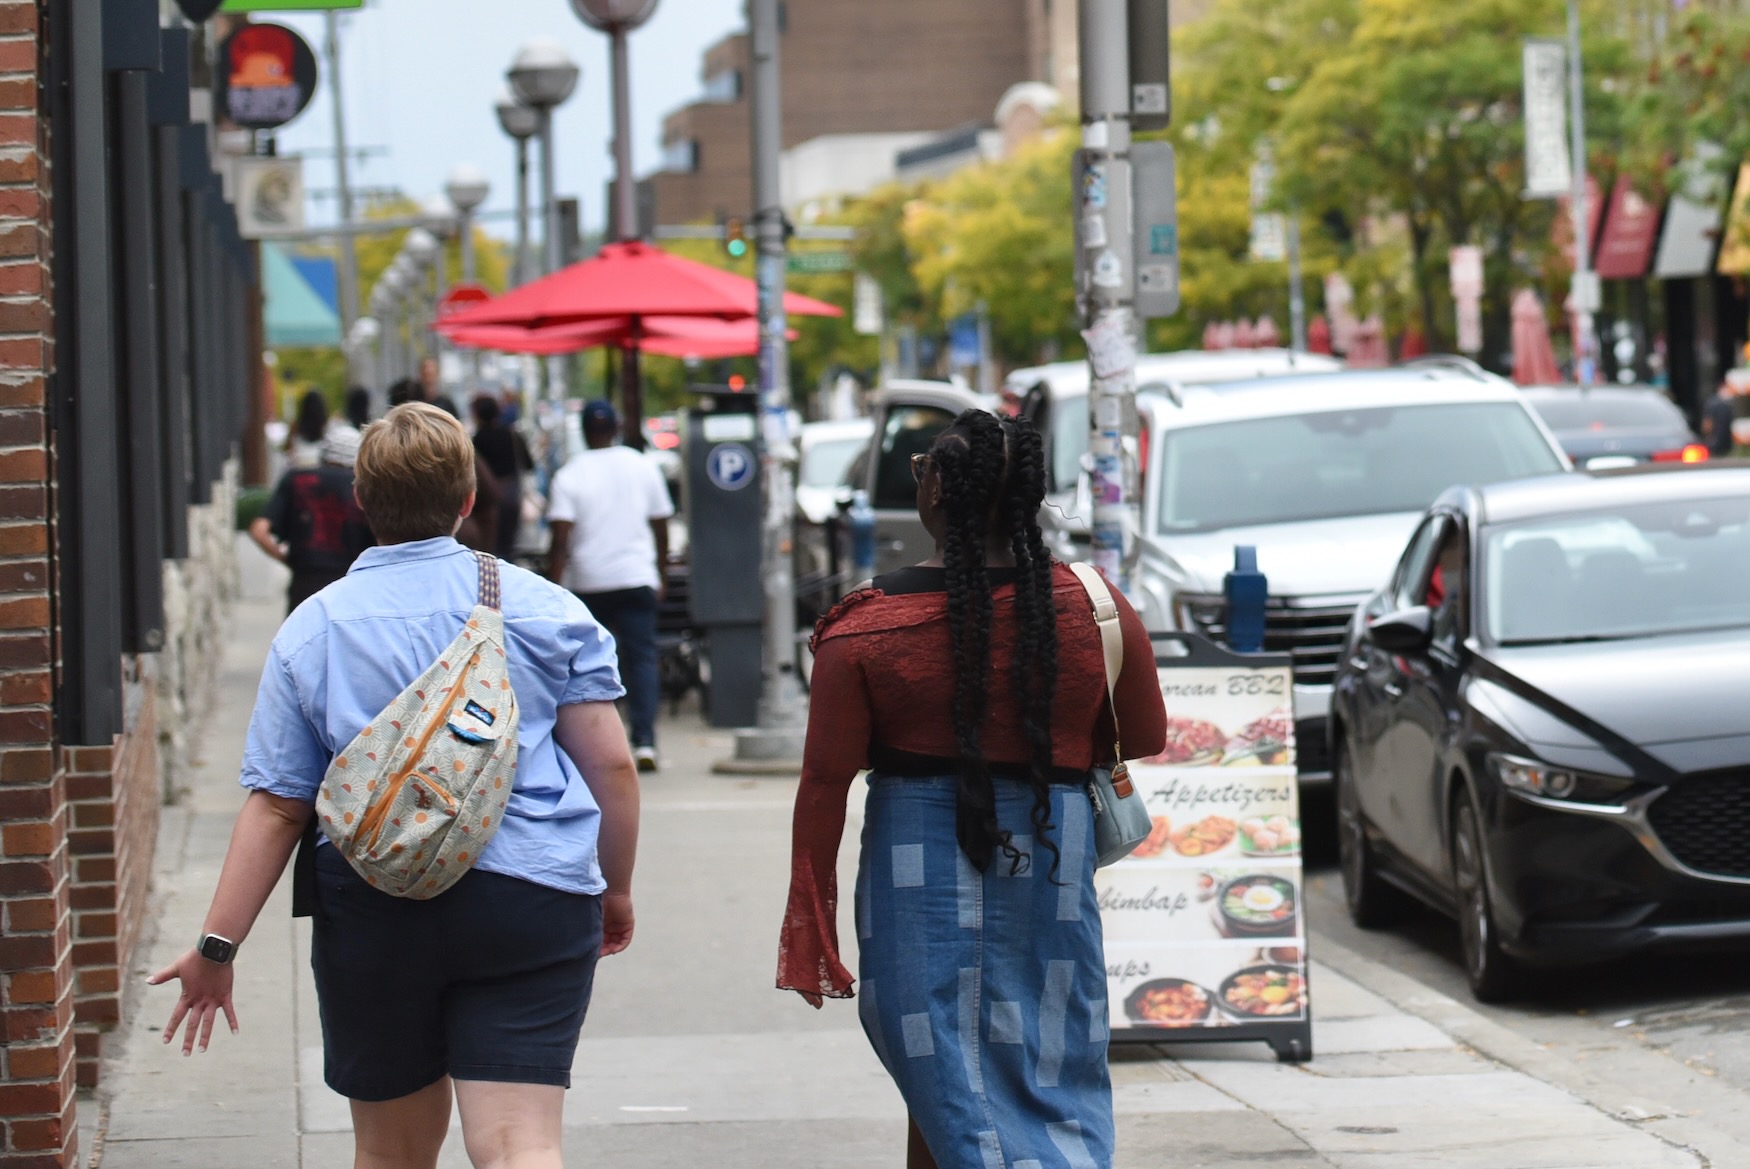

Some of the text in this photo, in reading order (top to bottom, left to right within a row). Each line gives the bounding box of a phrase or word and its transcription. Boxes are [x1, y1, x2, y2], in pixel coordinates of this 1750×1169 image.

[1161, 674, 1284, 696] orean BBQ
[1146, 777, 1289, 811] Appetizers
[1099, 885, 1187, 917] bimbap
[1106, 959, 1151, 986] ups
